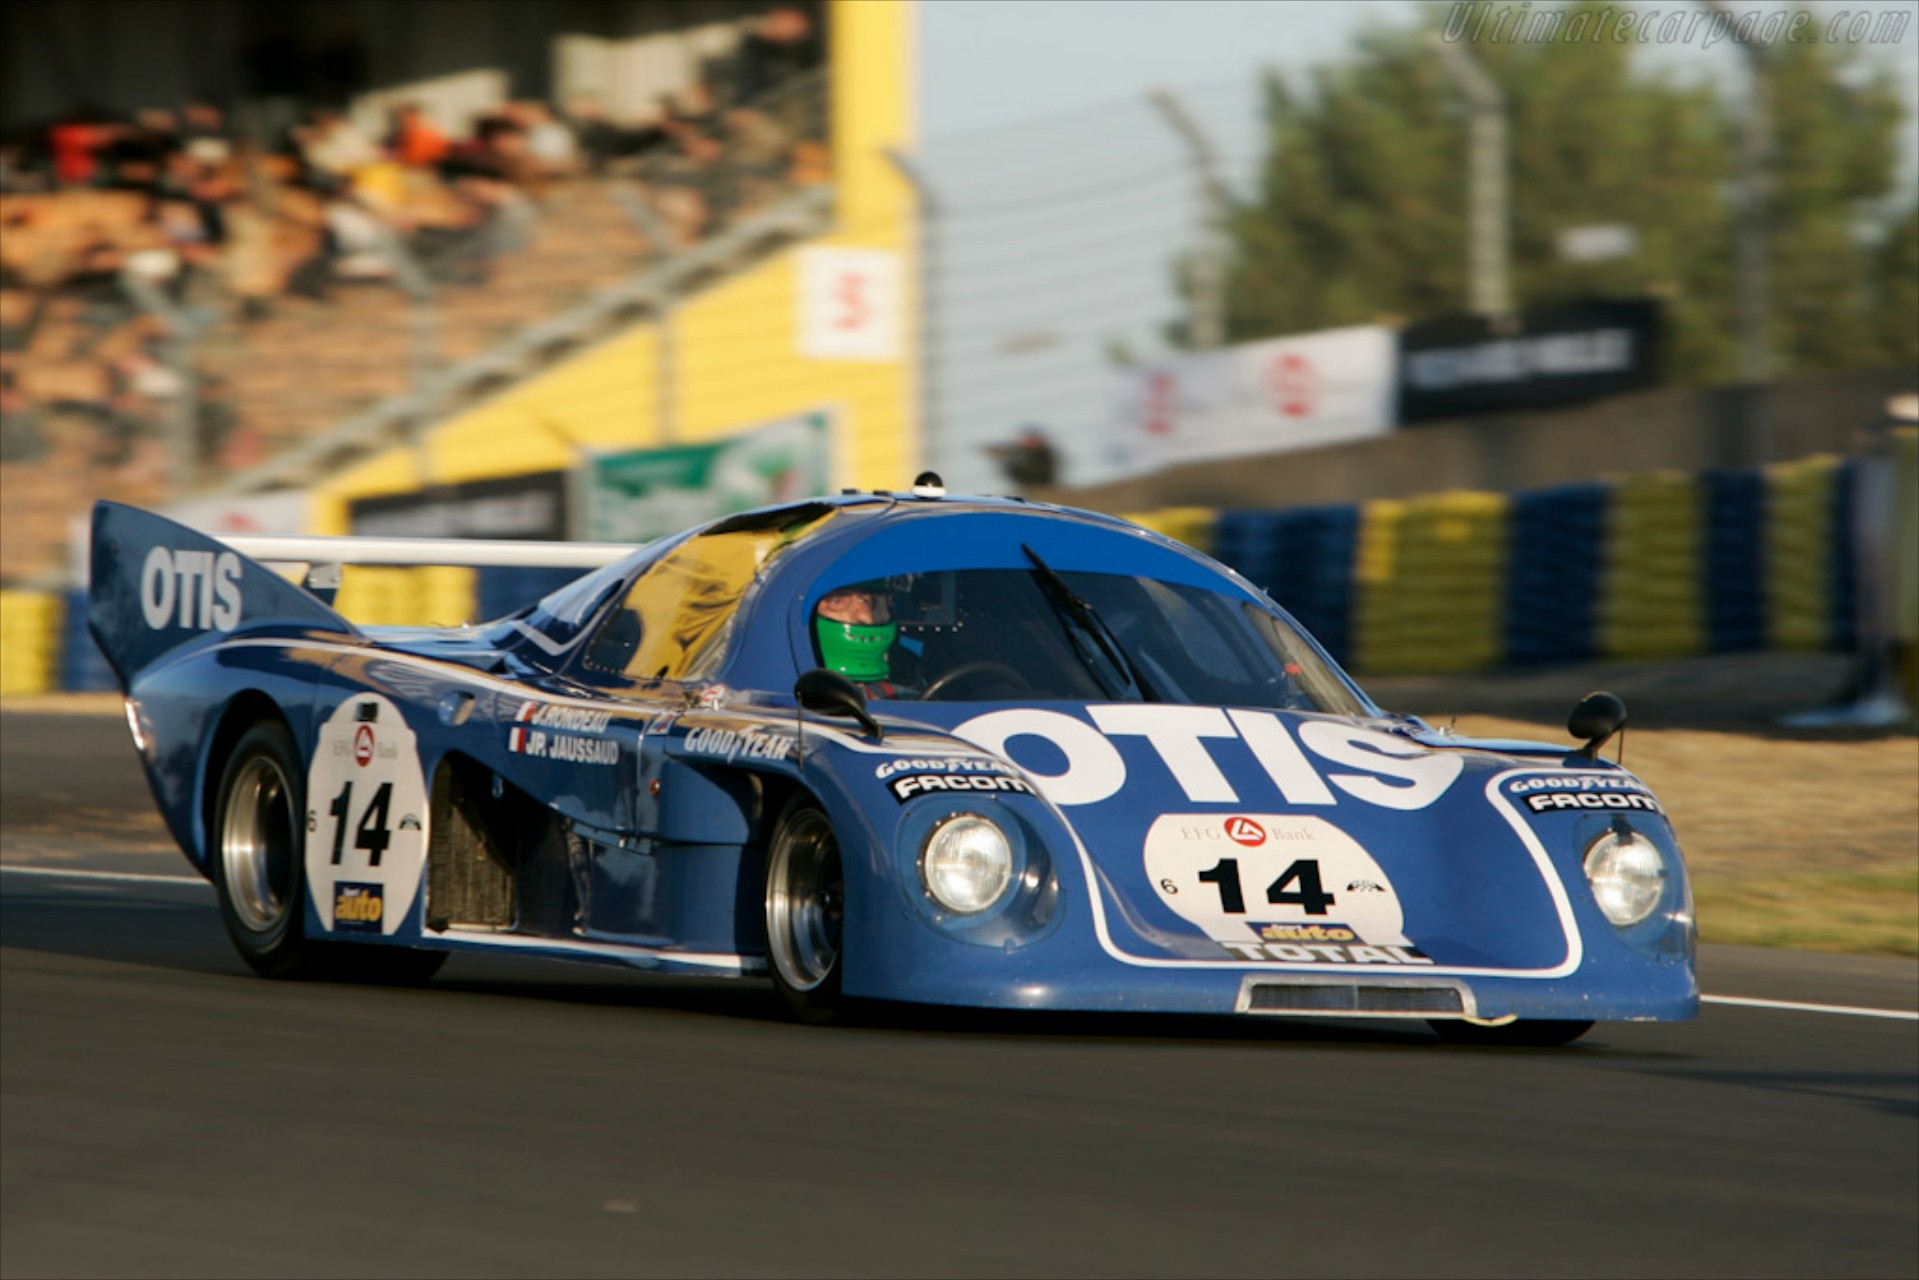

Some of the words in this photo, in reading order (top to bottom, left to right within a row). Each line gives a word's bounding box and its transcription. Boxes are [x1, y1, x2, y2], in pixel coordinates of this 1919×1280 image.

[141, 546, 242, 632] OTIS
[549, 735, 619, 765] JAUSSAUD
[684, 724, 794, 764] GOODYEAR
[950, 703, 1464, 811] OTIS
[894, 774, 1038, 799] FACOM
[329, 781, 393, 867] 14
[1181, 827, 1221, 841] EFG
[1272, 827, 1316, 841] Bank
[1160, 879, 1179, 895] 6
[1197, 858, 1335, 915] 14
[335, 890, 383, 922] auto
[1261, 925, 1355, 941] auto
[1219, 942, 1434, 965] TOTAL
